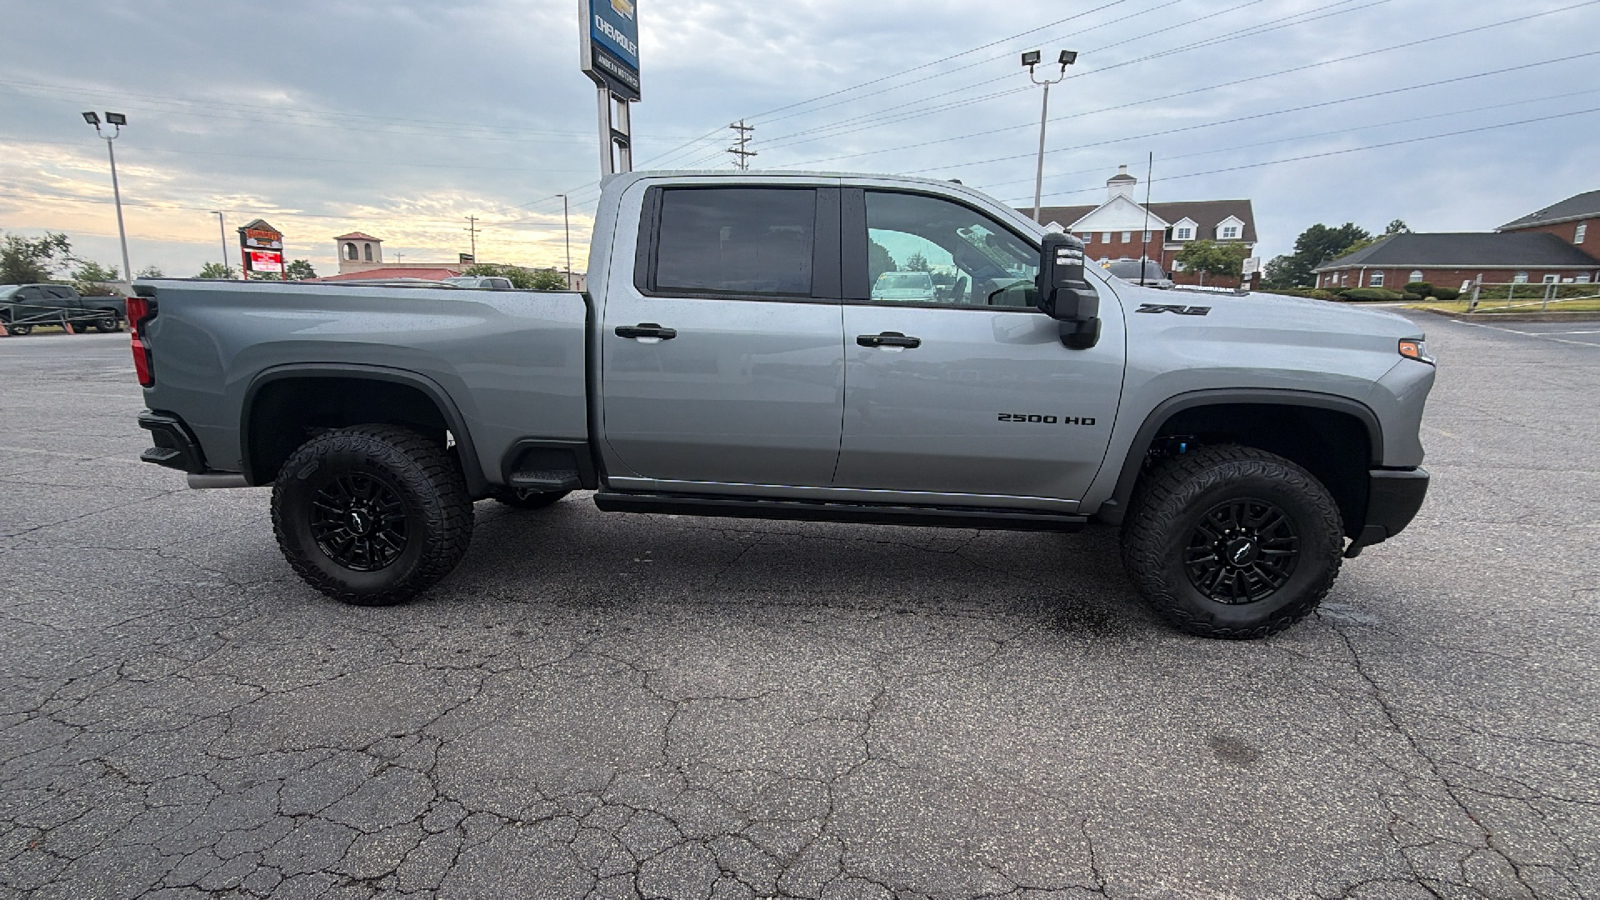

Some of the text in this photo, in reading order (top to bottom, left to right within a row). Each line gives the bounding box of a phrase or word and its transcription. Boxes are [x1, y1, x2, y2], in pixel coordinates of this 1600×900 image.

[595, 14, 637, 57] CHEVROLET
[1135, 303, 1212, 316] ZR2
[998, 413, 1095, 426] 2500 HD
